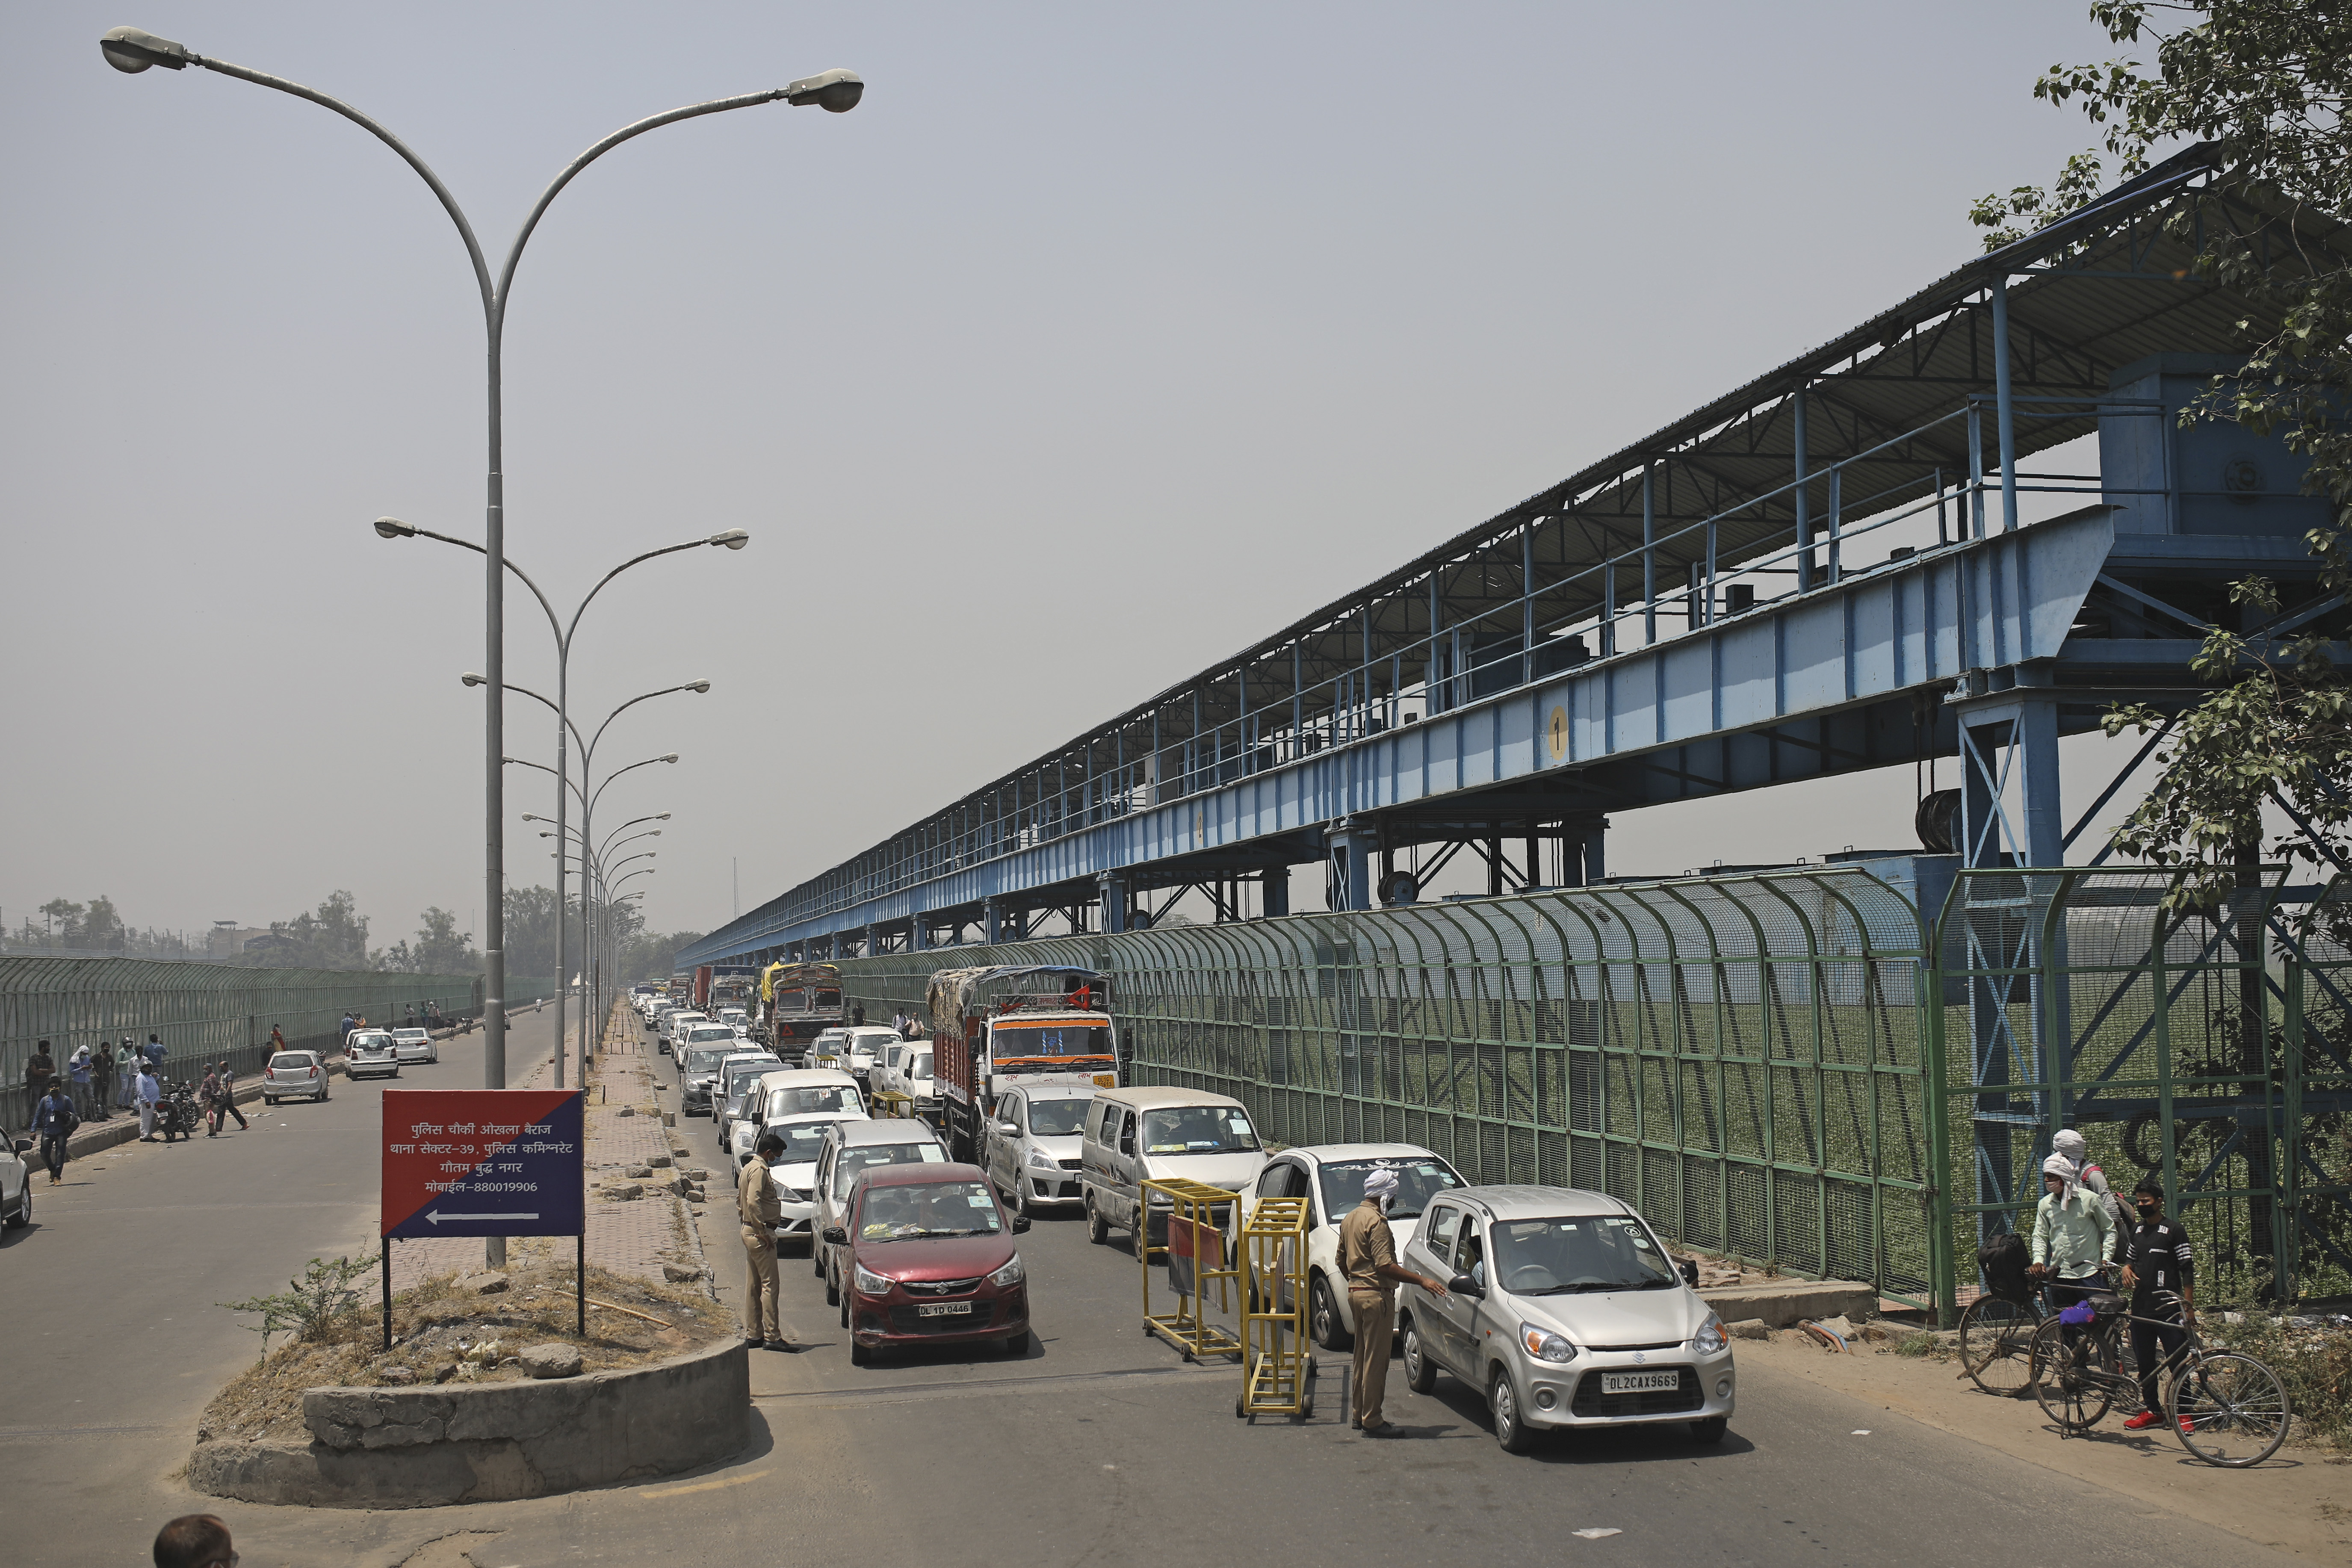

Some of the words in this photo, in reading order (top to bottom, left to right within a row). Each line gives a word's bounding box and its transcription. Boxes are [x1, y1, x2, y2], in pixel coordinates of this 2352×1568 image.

[1554, 717, 1560, 751] 1
[411, 1122, 444, 1138] पुलिस
[447, 1122, 476, 1134] चौकी
[480, 1122, 520, 1134] ओखला
[524, 1122, 552, 1134] बैराज
[390, 1144, 416, 1154] थाना
[484, 1142, 517, 1157] पुलिस
[440, 1160, 471, 1173] गौतम
[475, 1163, 493, 1176] बुद्ध
[498, 1163, 523, 1173] नगर
[921, 1307, 931, 1315] DL
[1610, 1375, 1677, 1389] DL2CAX9669
